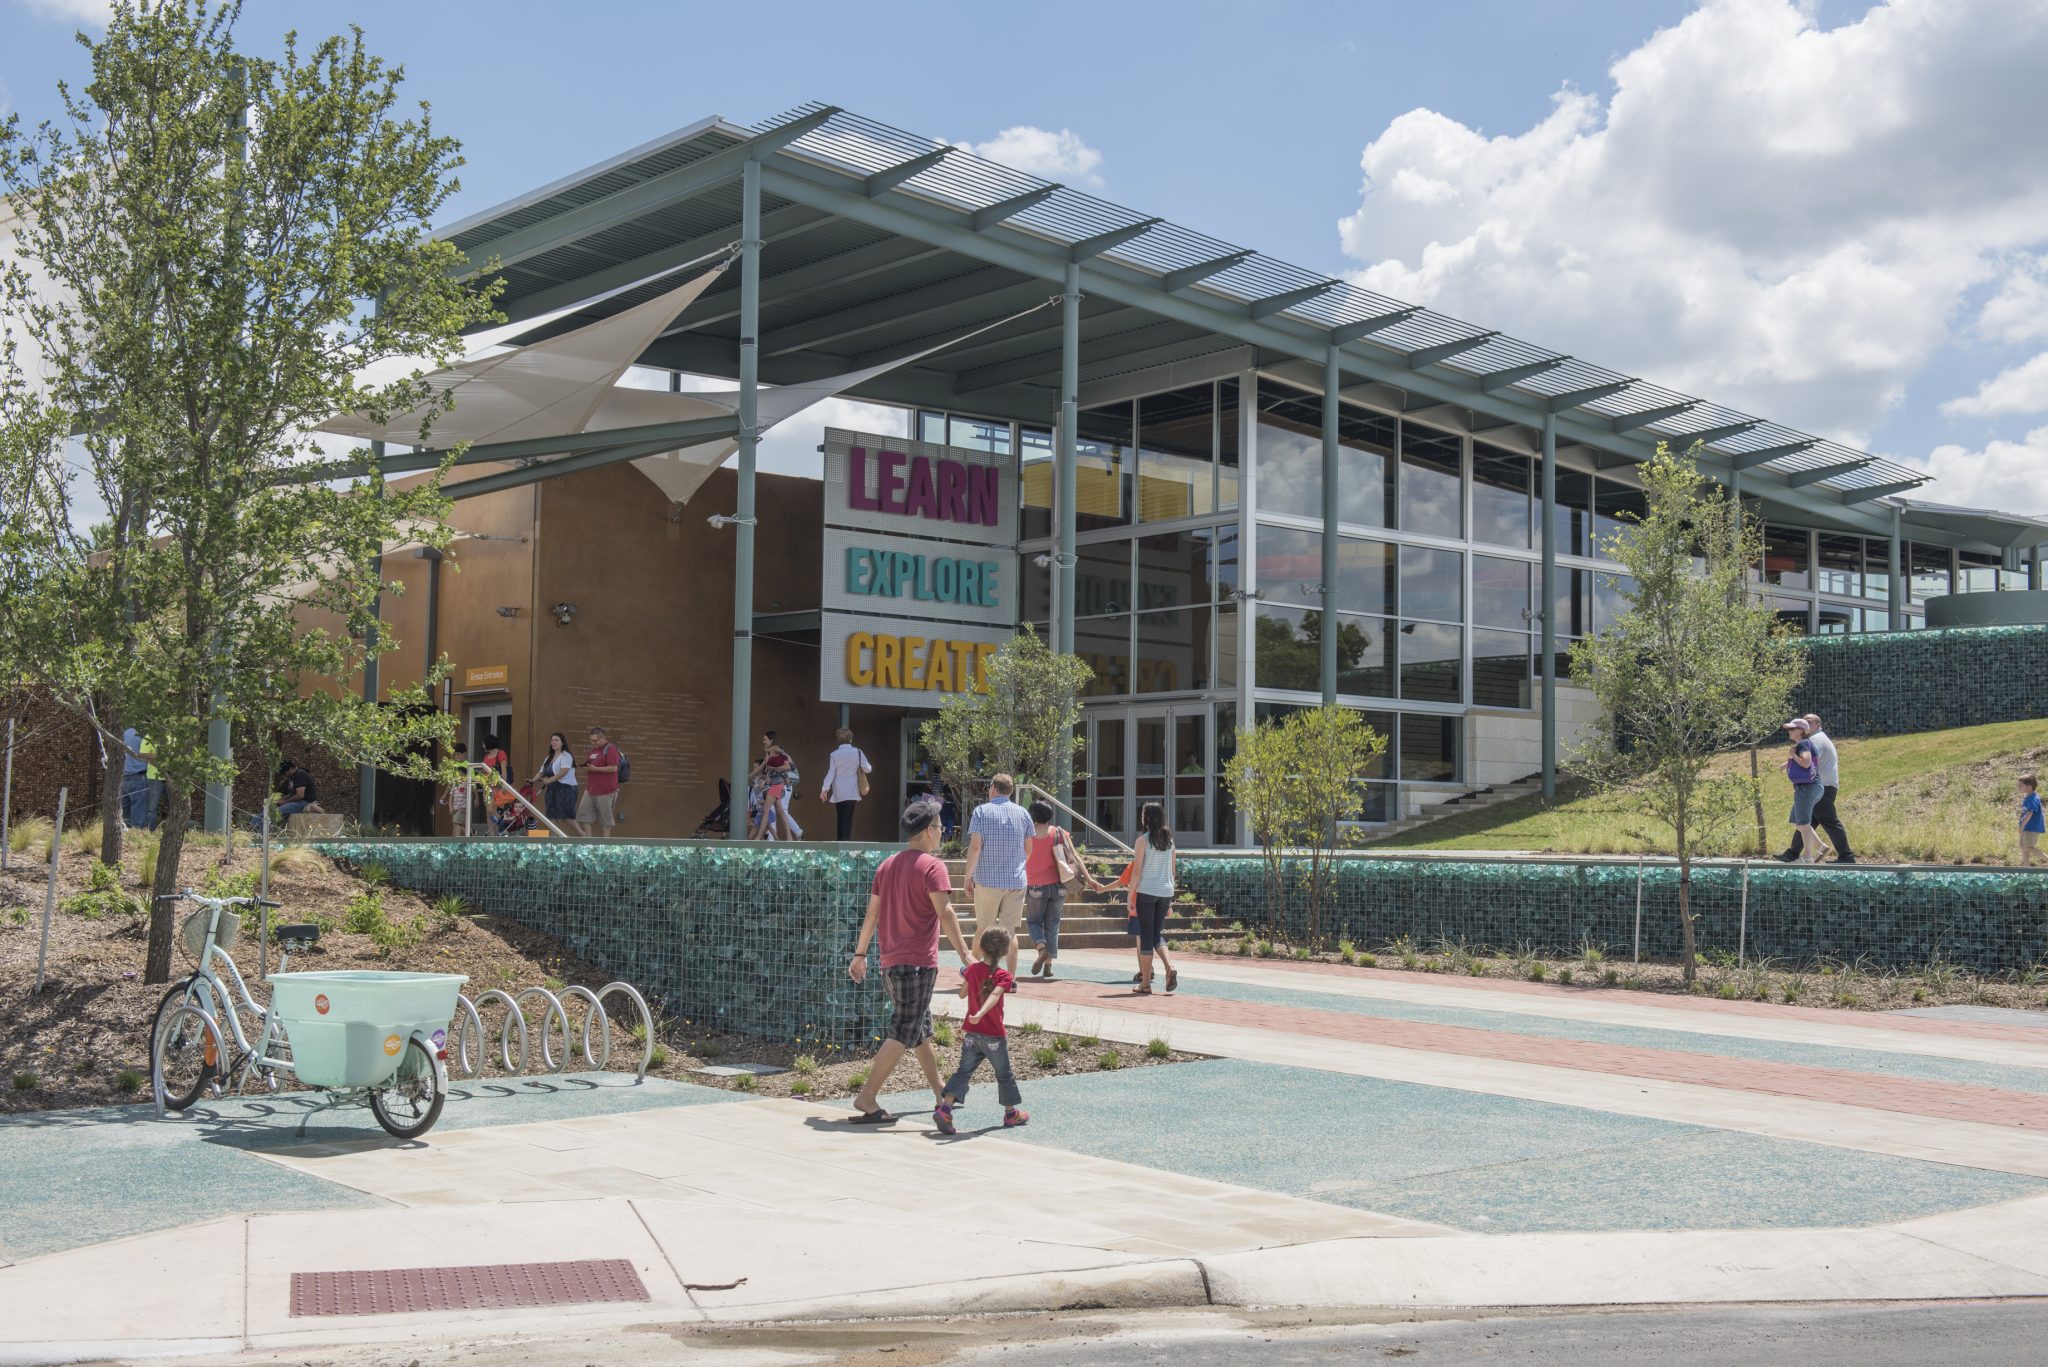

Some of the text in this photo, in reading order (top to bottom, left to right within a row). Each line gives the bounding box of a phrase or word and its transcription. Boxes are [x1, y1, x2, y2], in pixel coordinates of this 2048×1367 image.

[849, 447, 999, 526] LEARN
[847, 547, 999, 607] EXPLORE
[470, 671, 504, 681] Group Entrance
